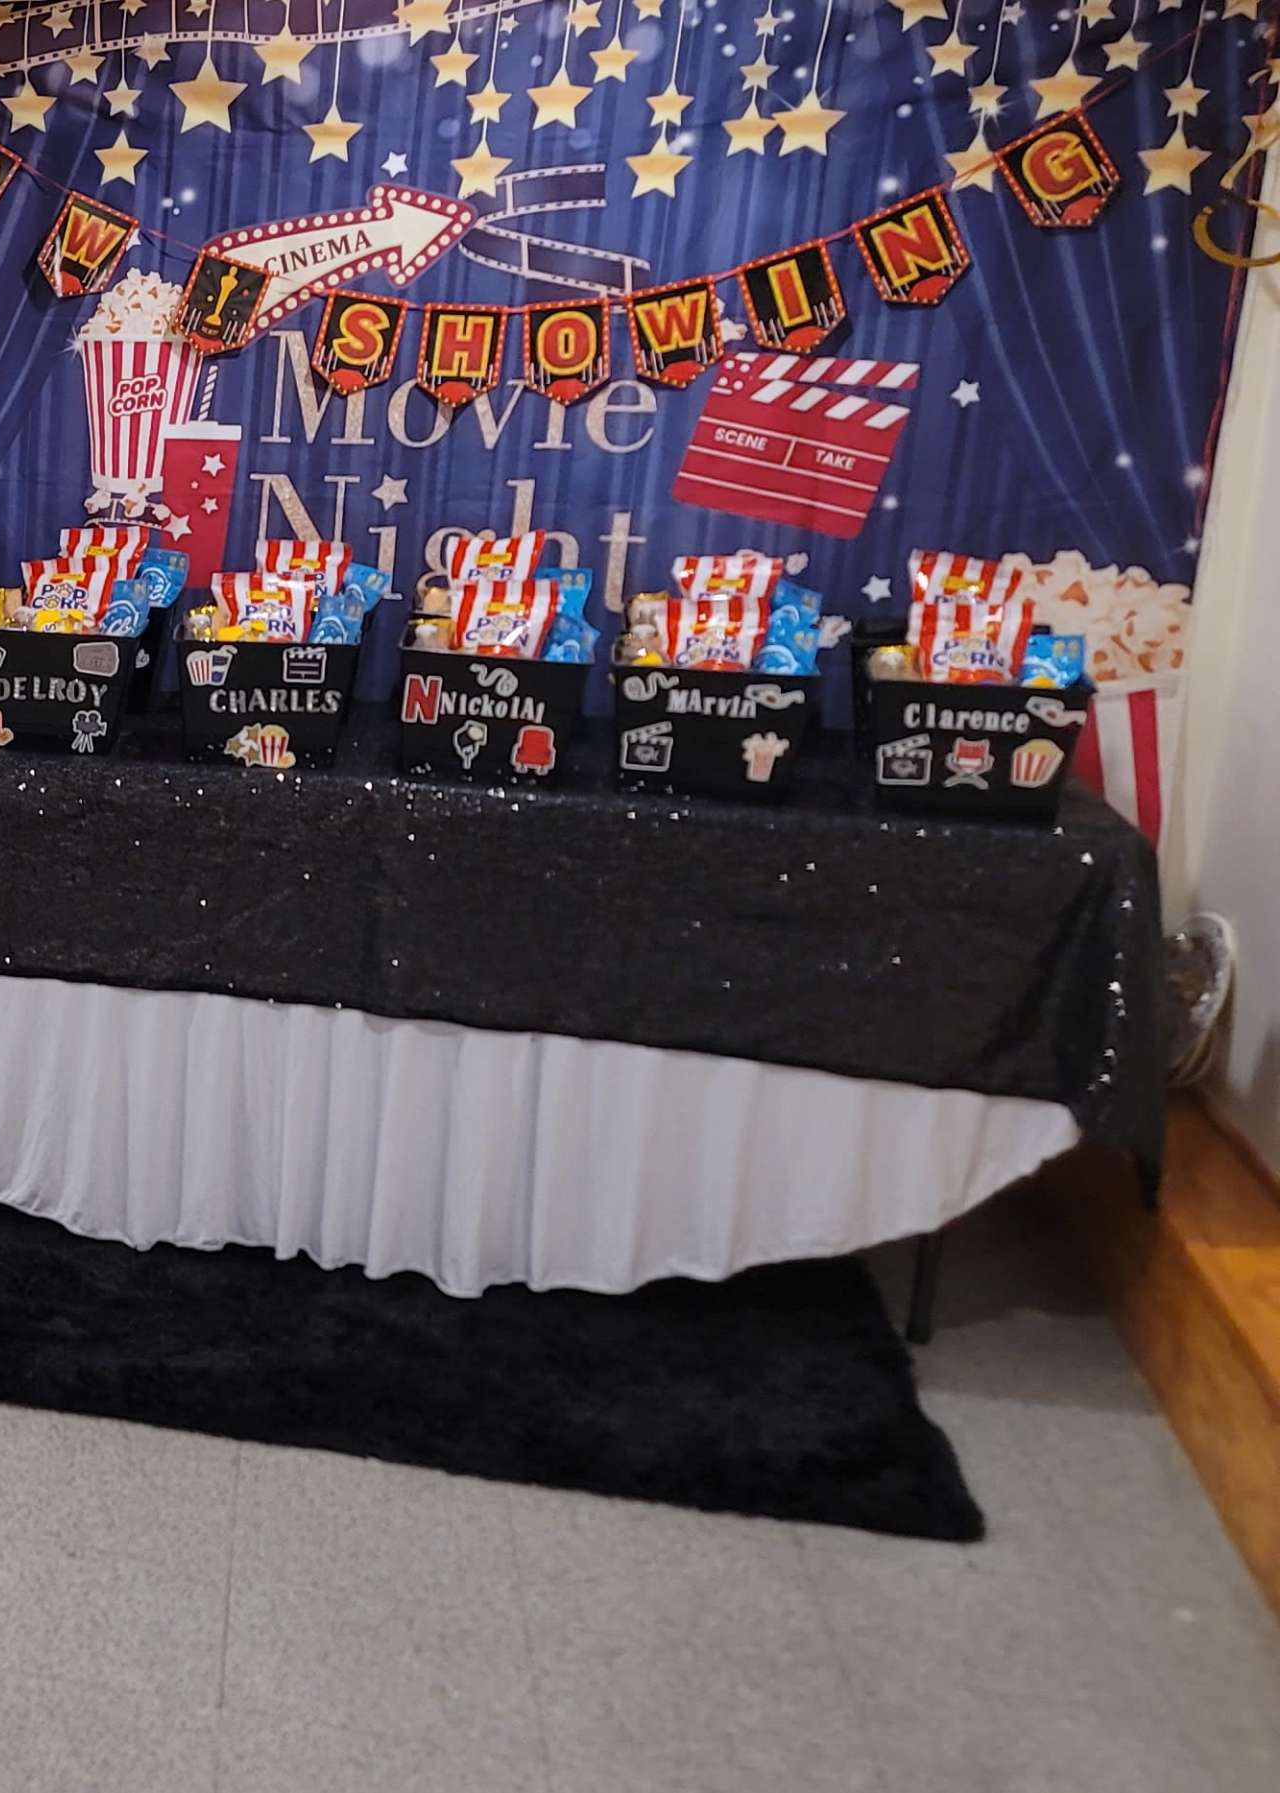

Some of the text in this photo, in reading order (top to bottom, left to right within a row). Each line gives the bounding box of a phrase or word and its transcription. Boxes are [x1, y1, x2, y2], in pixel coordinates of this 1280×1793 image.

[263, 229, 373, 277] CINEMA
[119, 377, 159, 398] POP
[260, 330, 657, 453] Movie
[111, 392, 165, 414] CORN
[714, 428, 768, 450] SCENE
[815, 449, 856, 471] TAKE
[209, 688, 342, 714] CHARLES
[903, 703, 1031, 734] Clarence
